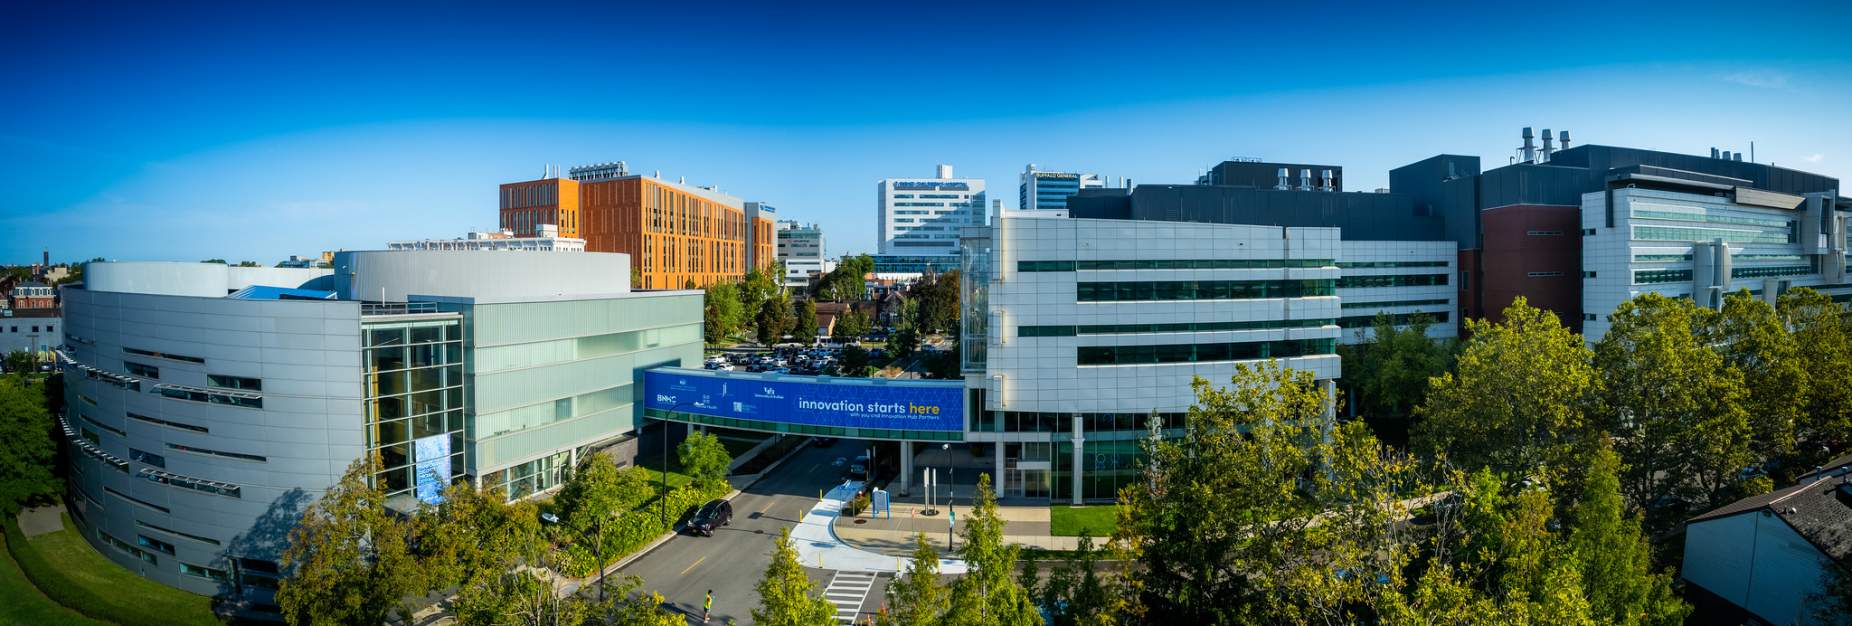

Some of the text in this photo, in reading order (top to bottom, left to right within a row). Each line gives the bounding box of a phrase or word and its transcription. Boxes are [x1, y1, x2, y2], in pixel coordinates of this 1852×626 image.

[799, 397, 940, 415] innovation starts here
